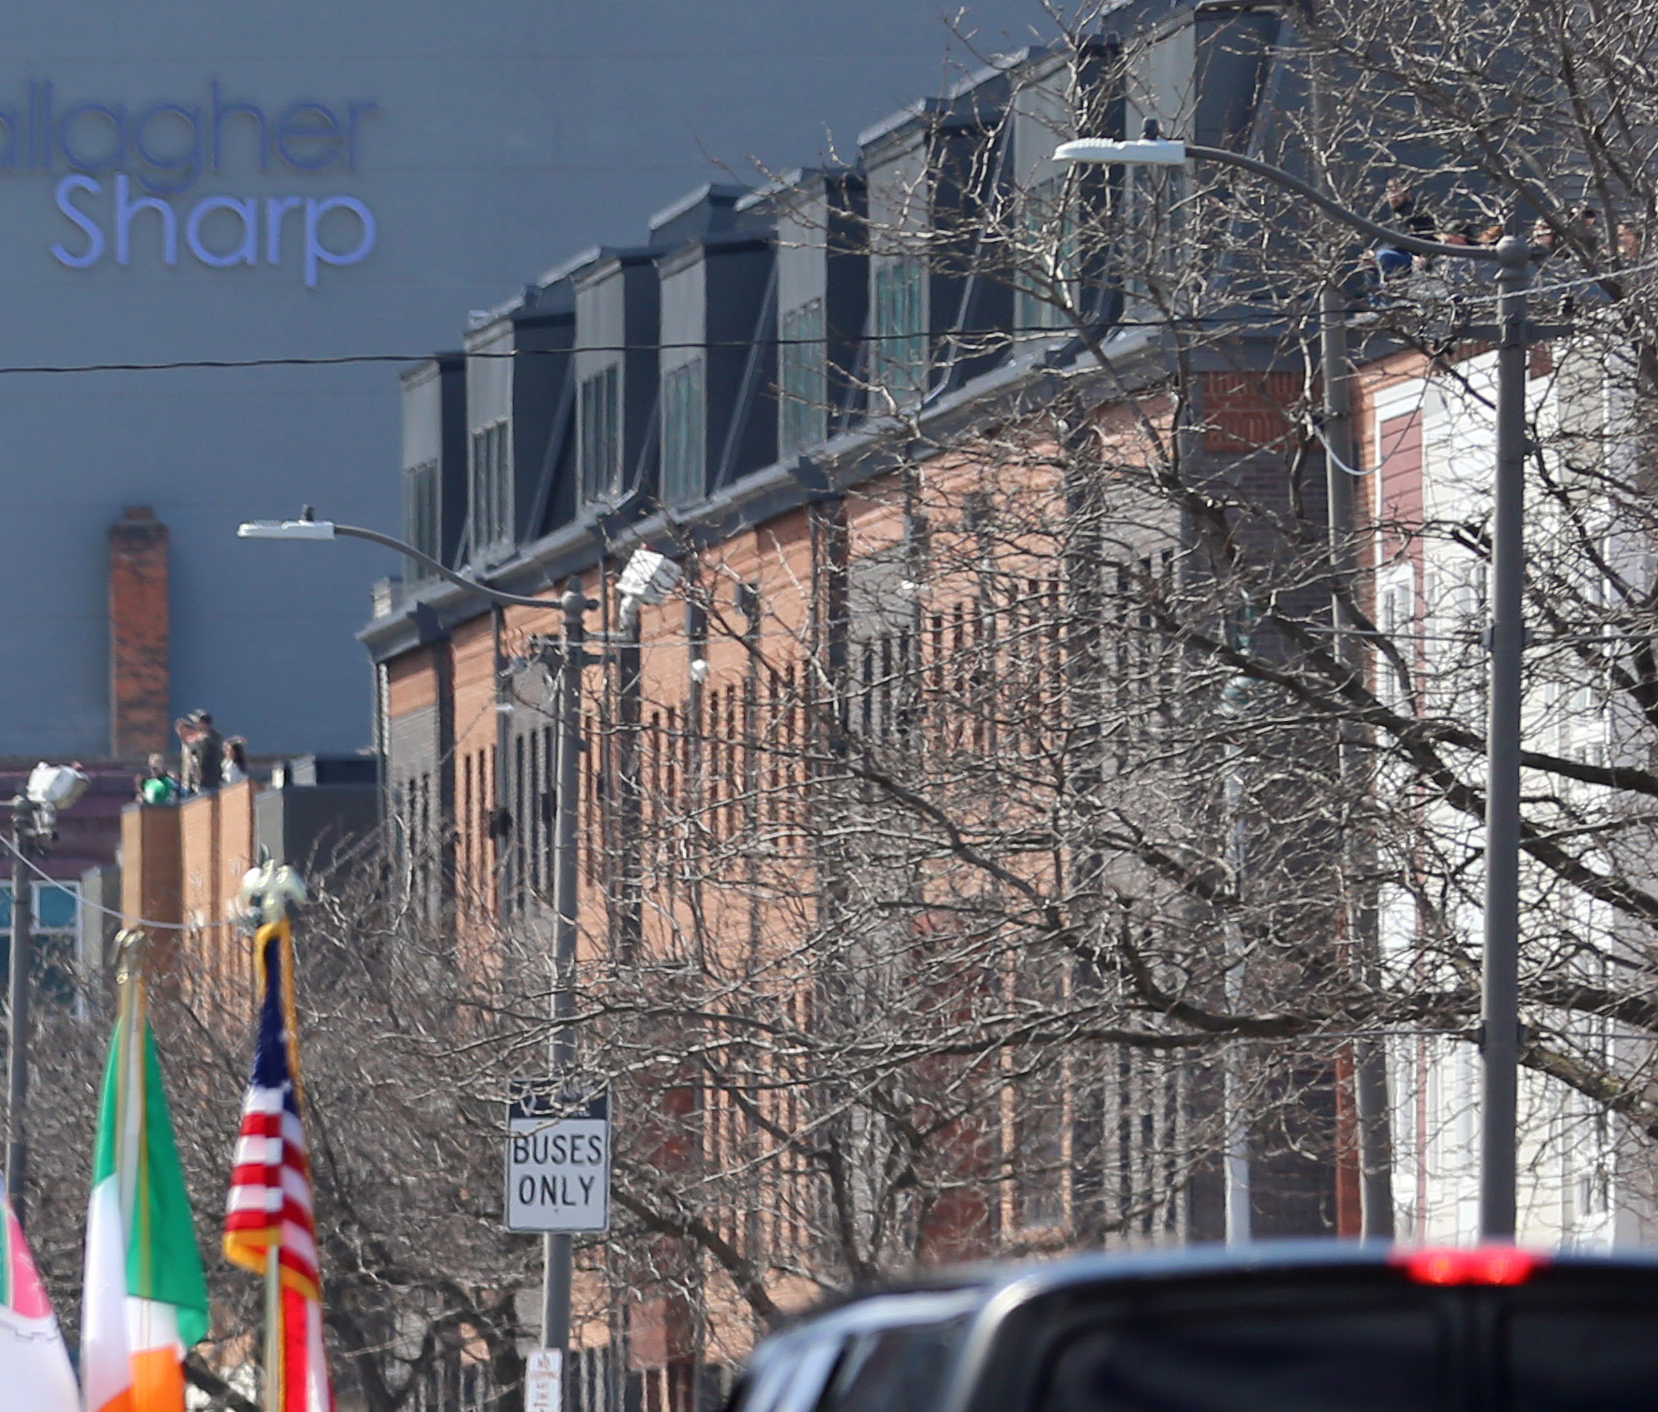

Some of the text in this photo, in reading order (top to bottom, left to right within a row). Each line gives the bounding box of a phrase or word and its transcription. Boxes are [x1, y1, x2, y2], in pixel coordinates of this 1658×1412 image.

[49, 173, 376, 288] Sharp
[513, 1134, 603, 1165] BUSES
[518, 1174, 595, 1207] ONLY
